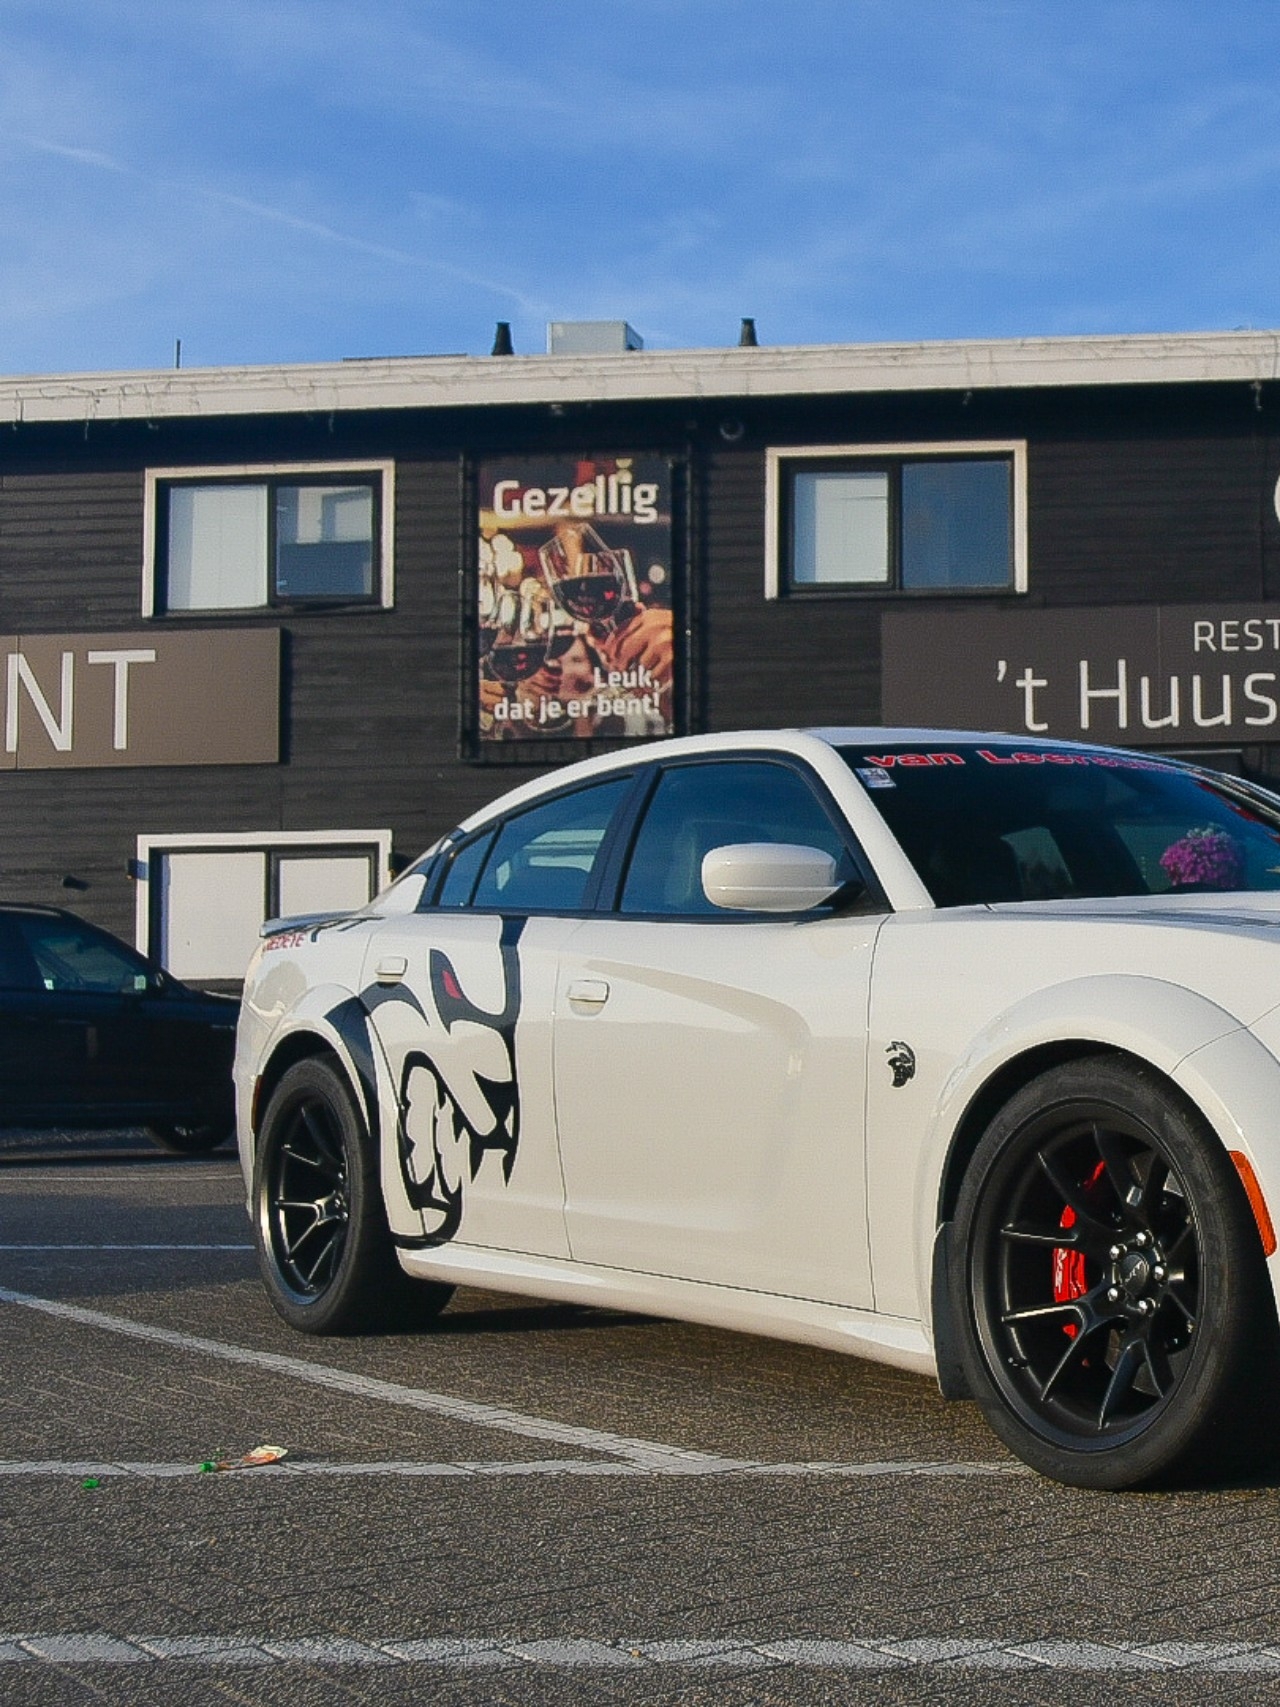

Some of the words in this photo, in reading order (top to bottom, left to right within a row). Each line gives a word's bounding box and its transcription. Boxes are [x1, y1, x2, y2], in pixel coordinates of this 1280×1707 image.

[493, 474, 659, 524] Gezellig
[594, 667, 660, 691] Leuk,
[1080, 659, 1277, 729] Huus
[7, 650, 155, 751] NT
[494, 699, 534, 721] dat
[539, 697, 562, 724] je
[566, 700, 590, 720] er
[597, 696, 660, 717] bent!
[863, 753, 966, 768] van
